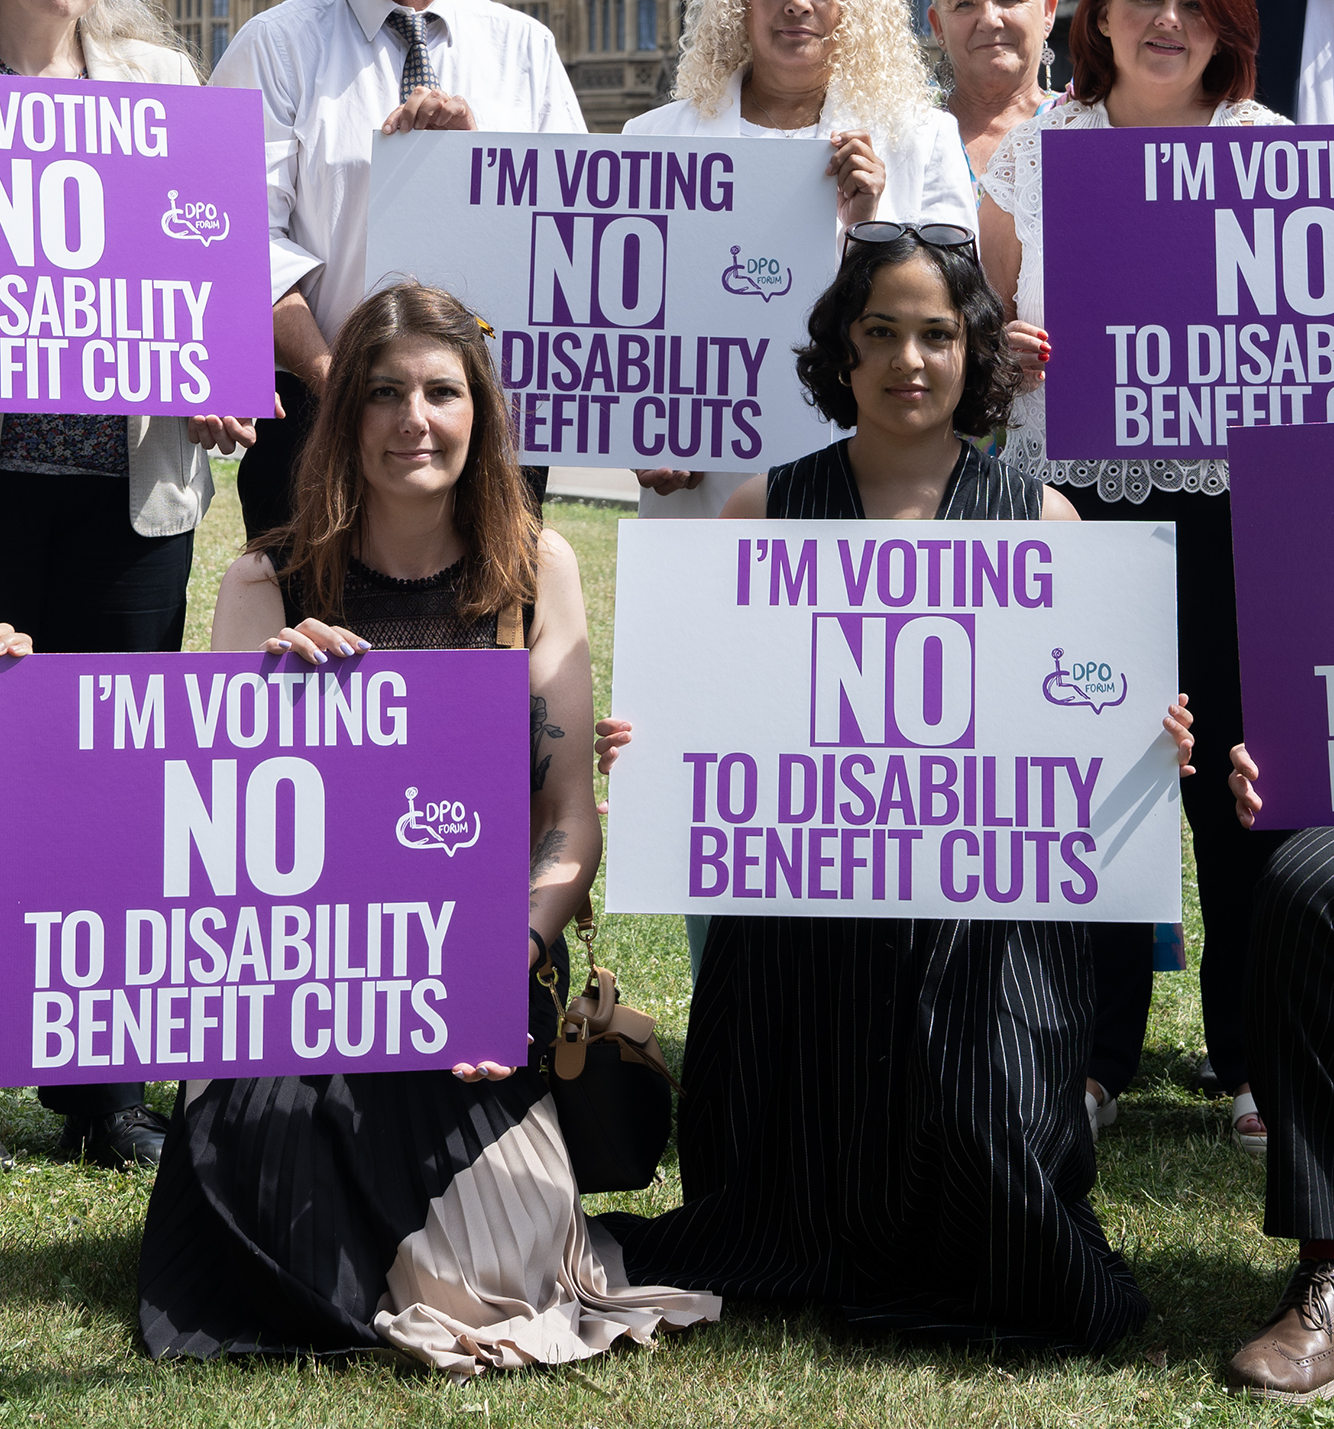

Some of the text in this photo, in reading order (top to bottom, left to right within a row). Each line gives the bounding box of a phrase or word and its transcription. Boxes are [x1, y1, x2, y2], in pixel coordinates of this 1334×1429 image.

[470, 147, 733, 212] I'M VOTING
[1144, 143, 1214, 201] I'M
[185, 203, 217, 219] DPO
[196, 220, 220, 230] FORUM
[533, 215, 664, 326] NO
[747, 259, 780, 275] DPO
[757, 275, 782, 285] FORUM
[82, 339, 211, 404] CUTS
[501, 330, 769, 397] DISABILITY
[1106, 324, 1171, 384] TO
[511, 393, 762, 459] EFIT CUTS
[737, 539, 1053, 608] I'M VOTING
[815, 616, 972, 746] NO
[1073, 663, 1112, 681] DPO
[1085, 682, 1116, 694] FORUM
[78, 671, 407, 750] I'M VOTING
[427, 801, 466, 822] DPO
[683, 752, 1104, 829] TO DISABILITY
[163, 756, 325, 898] NO
[438, 822, 469, 834] FORUM
[689, 827, 1098, 904] BENEFIT CUTS
[24, 901, 456, 988] TO DISABILITY
[31, 978, 448, 1068] BENEFIT CUTS
